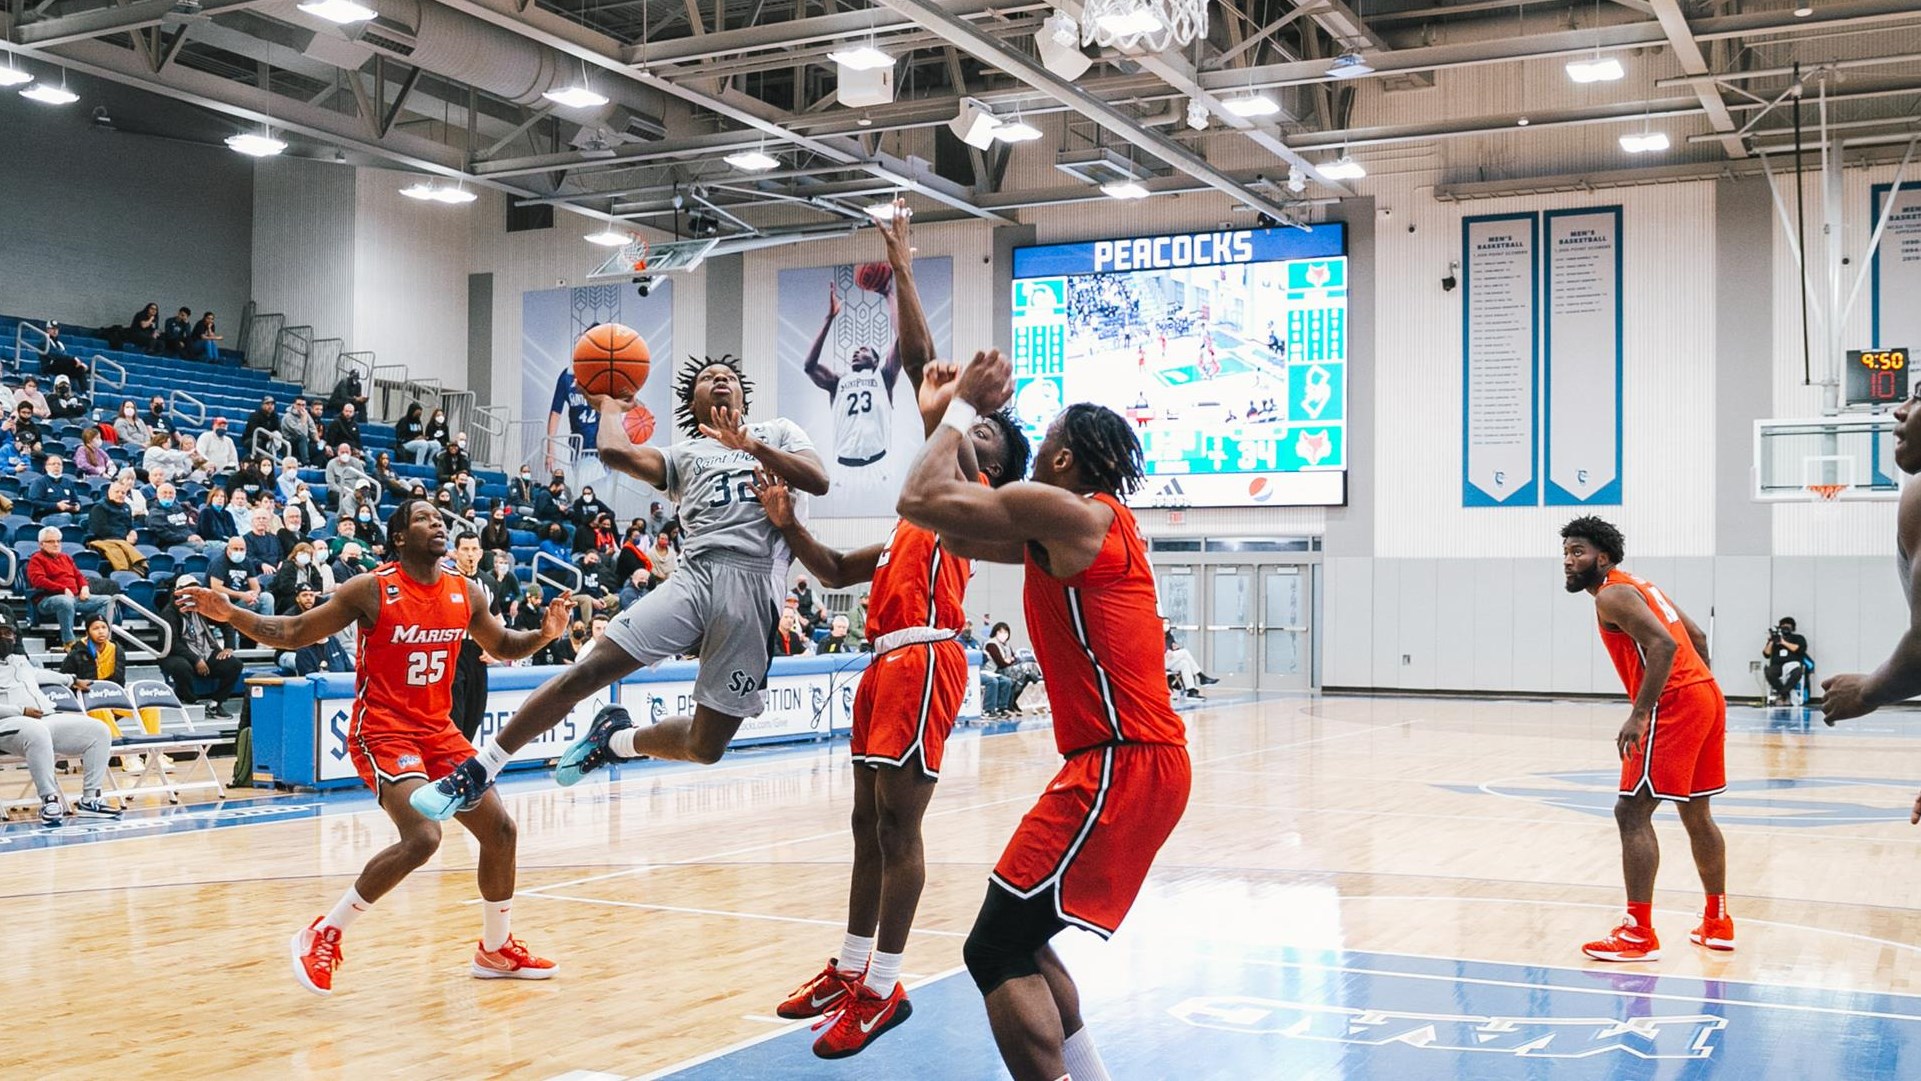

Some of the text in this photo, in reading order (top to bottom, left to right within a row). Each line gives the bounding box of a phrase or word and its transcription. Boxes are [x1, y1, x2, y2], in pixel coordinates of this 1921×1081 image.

[1559, 236, 1607, 245] BASKETBALL
[1571, 229, 1595, 237] MEN'S
[1094, 230, 1253, 272] PEACOCKS
[1477, 242, 1523, 250] BASKETBALL
[1862, 352, 1904, 370] 9:50
[1870, 371, 1896, 399] 10
[847, 390, 872, 416] 23
[579, 409, 597, 424] 42
[693, 454, 727, 476] Saint
[708, 469, 762, 508] 32
[391, 624, 464, 645] MARIST
[406, 650, 449, 687] 25
